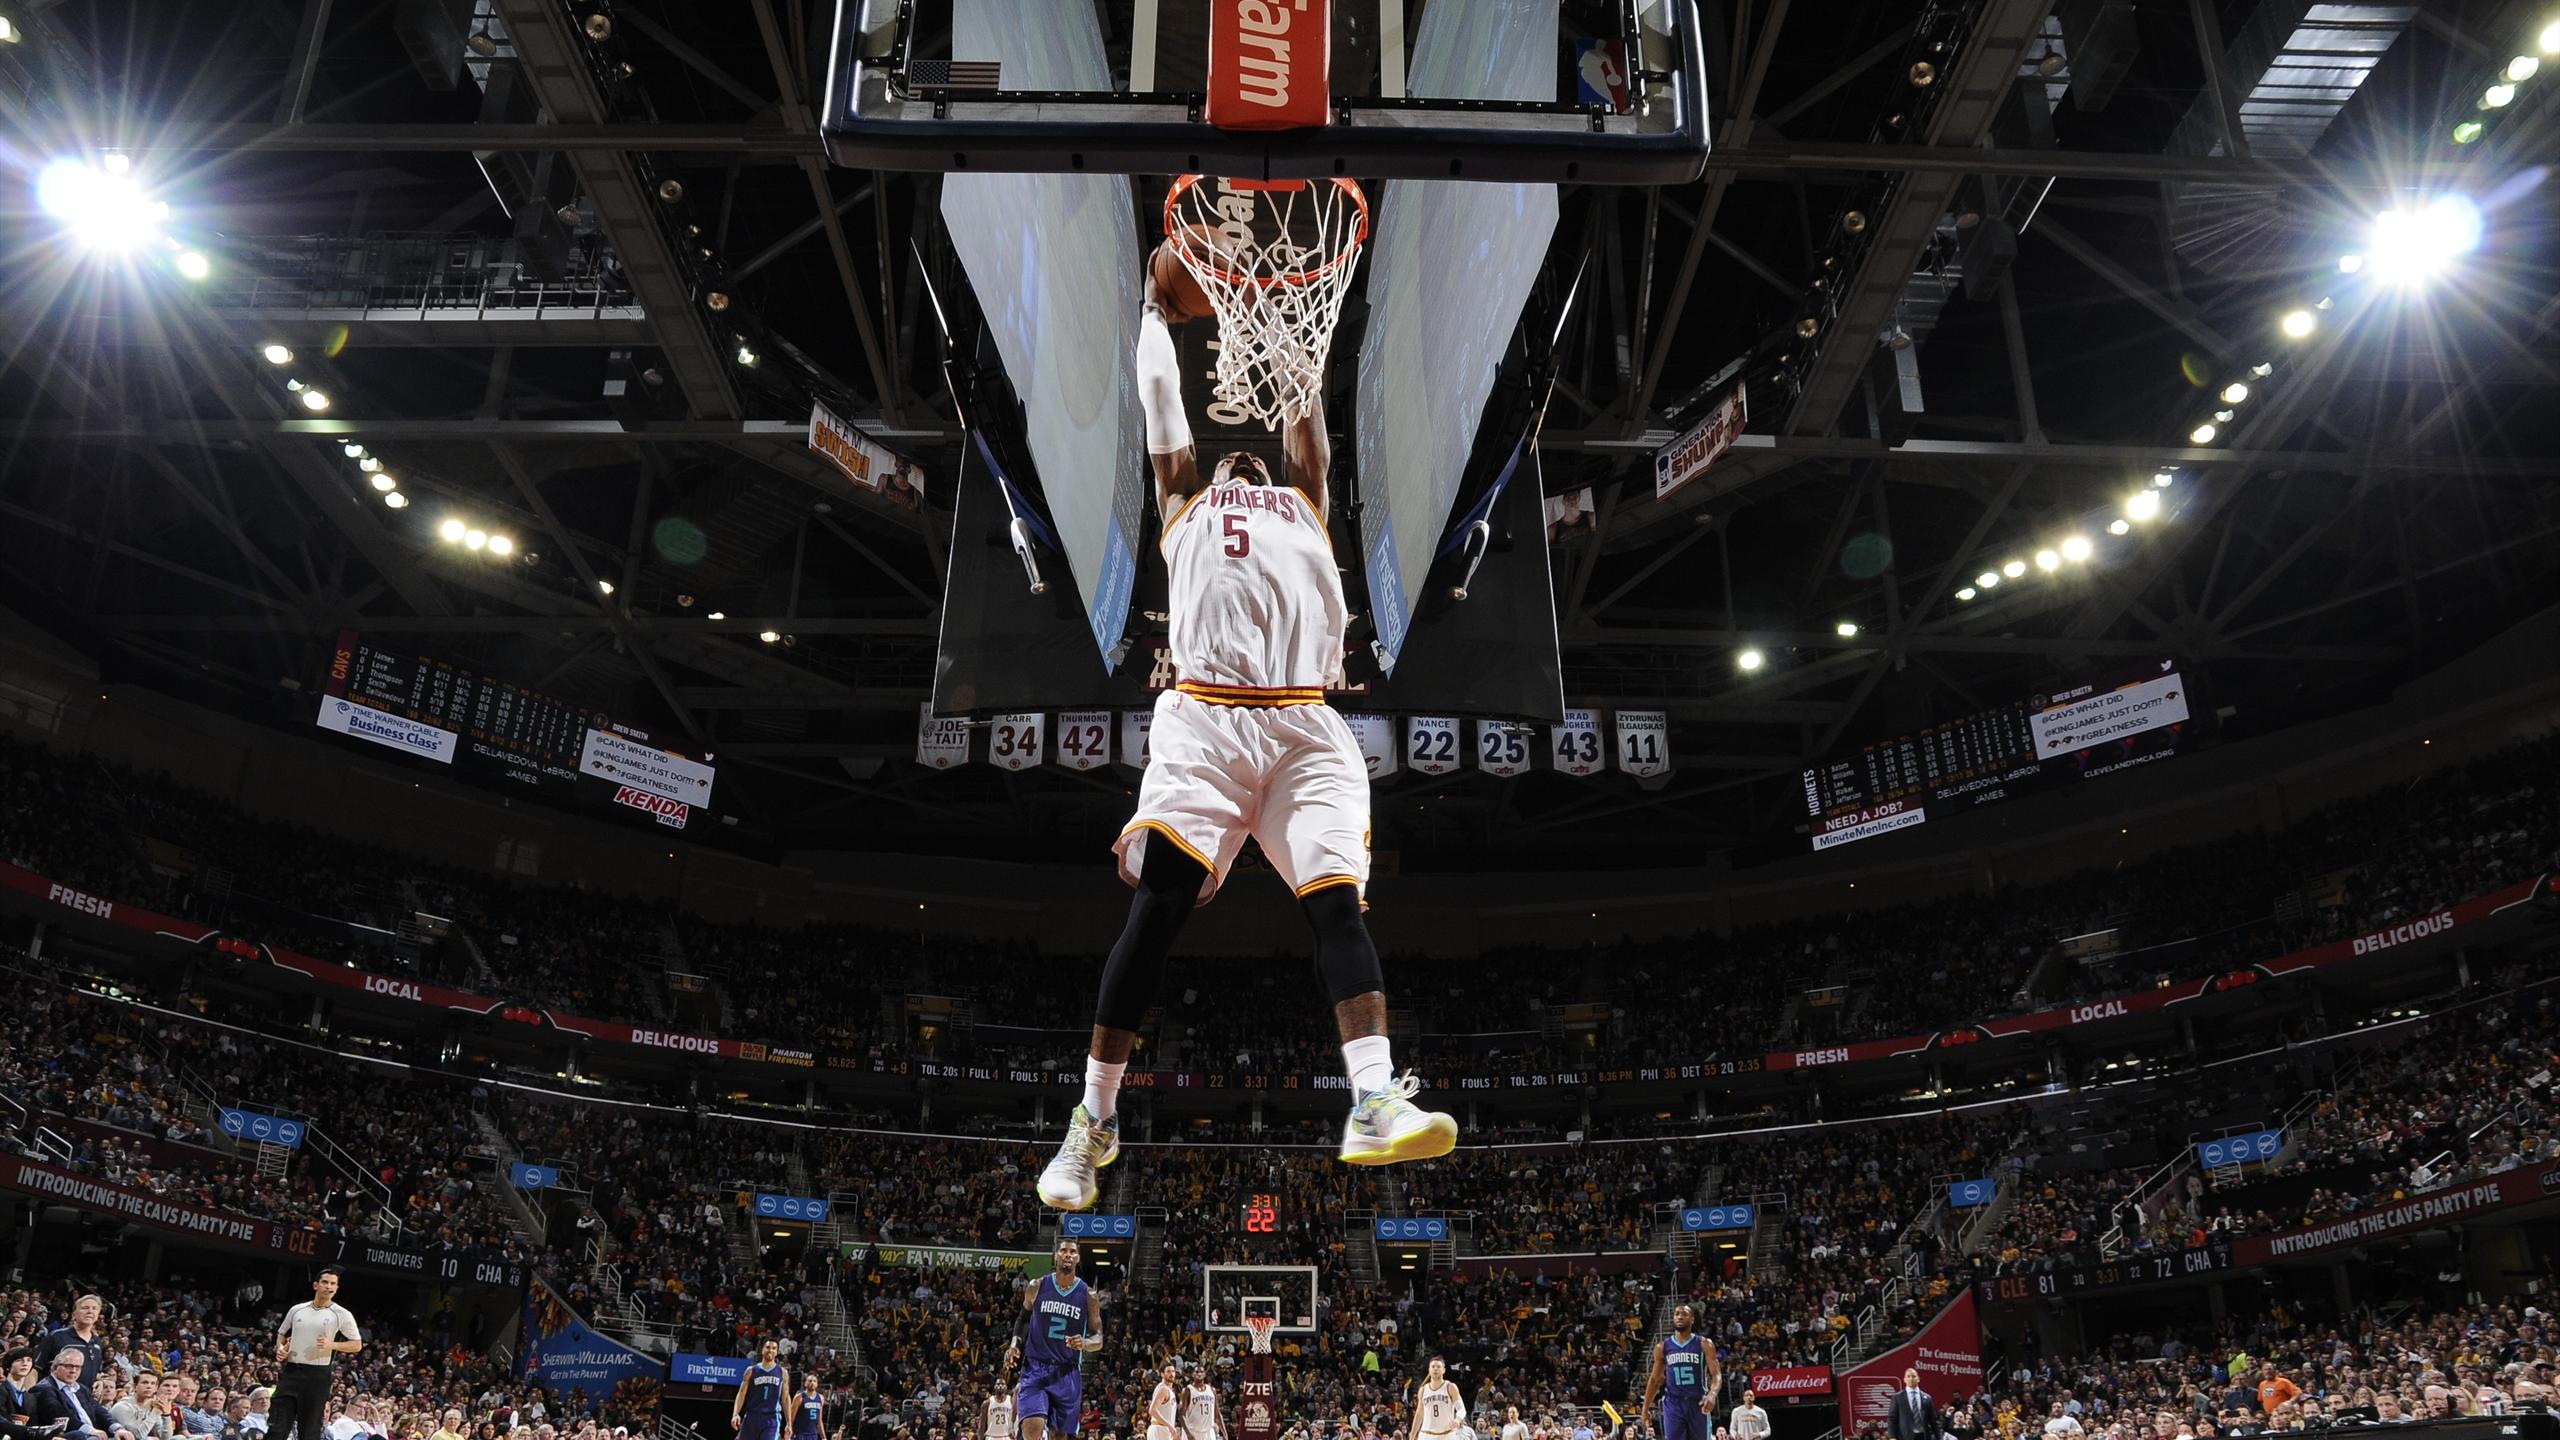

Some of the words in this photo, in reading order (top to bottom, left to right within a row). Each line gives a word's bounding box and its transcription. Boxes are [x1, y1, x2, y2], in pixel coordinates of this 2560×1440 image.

[1238, 0, 1307, 107] arm
[827, 411, 862, 450] TEAM
[1670, 411, 1722, 460] GENERATION
[814, 421, 870, 480] SWISH
[1223, 514, 1250, 558] 5
[1378, 534, 1403, 648] FirstEnergy
[331, 649, 351, 680] CAVS
[1005, 714, 1032, 723] CARR
[1061, 714, 1109, 723] THURMOND
[1618, 714, 1664, 722] ZYDRUNAS
[2042, 709, 2075, 724] @CAVS
[2076, 699, 2104, 714] WHAT
[2106, 694, 2124, 706] DID
[350, 715, 404, 740] Business
[353, 707, 372, 719] TIME
[374, 713, 411, 730] WARNER
[412, 724, 440, 739] CABLE
[938, 721, 964, 731] JOE
[1417, 720, 1451, 728] NANCE
[1619, 722, 1665, 730] ILGAUSKAS
[2045, 715, 2105, 737] @KINGJAMES
[2107, 707, 2130, 720] JUST
[934, 733, 966, 744] TAIT
[996, 725, 1037, 757] 34
[1063, 725, 1104, 757] 42
[1413, 730, 1454, 761] 22
[1483, 732, 1525, 763] 25
[1558, 731, 1599, 763] 43
[1627, 734, 1660, 763] 11
[596, 736, 625, 751] @CAVS
[628, 745, 653, 759] WHAT
[653, 753, 668, 764] DID
[593, 749, 647, 771] @KINGJAMES
[649, 766, 668, 778] JUST
[2084, 748, 2175, 779] CLEVELANDYMCA.ORG
[614, 786, 689, 820] KENDA
[1803, 769, 1821, 817] HORNETS
[657, 814, 685, 828] TIRES
[1825, 814, 1858, 831] NEED
[1861, 811, 1871, 822] A
[1873, 801, 1903, 818] JOB?
[1819, 814, 1919, 847] MinuteMenInc.com
[49, 883, 113, 919] FRESH
[2352, 911, 2455, 956] DELICIOUS
[364, 975, 422, 1001] LOCAL
[2070, 1000, 2128, 1024] LOCAL
[631, 1029, 719, 1054] DELICIOUS
[767, 1055, 816, 1068] FIREWORKS
[772, 1048, 813, 1060] PHANTOM
[1795, 1047, 1849, 1068] FRESH
[961, 1066, 966, 1079] 1
[969, 1067, 990, 1080] FULL
[1010, 1070, 1038, 1083] FOULS
[1041, 1072, 1048, 1084] 3
[1058, 1073, 1080, 1084] FG%
[1558, 1073, 1579, 1084] FULL
[1582, 1072, 1589, 1083] 3
[1619, 1070, 1633, 1081] PM
[1640, 1068, 1658, 1080] PHI
[1664, 1067, 1676, 1080] 36
[1682, 1065, 1701, 1078] DET
[1704, 1063, 1717, 1076] 55
[1737, 1059, 1760, 1073] 2:35
[1124, 1073, 1154, 1087] CAVS
[1176, 1074, 1190, 1087] 81
[1209, 1074, 1224, 1088] 22
[1243, 1075, 1269, 1088] 3:31
[1313, 1076, 1352, 1090] HORNE
[1436, 1078, 1450, 1089] 48
[1462, 1077, 1490, 1088] FOULS
[1492, 1077, 1500, 1088] 2
[17, 1165, 116, 1209] INTRODUCING
[116, 1193, 143, 1216] THE
[144, 1200, 179, 1224] CAVS
[181, 1209, 227, 1235] PARTY
[229, 1220, 254, 1241] PIE
[1252, 1194, 1280, 1208] 3:31
[1247, 1208, 1275, 1232] 22
[2270, 1220, 2360, 1256] INTRODUCING
[2360, 1214, 2387, 1237] THE
[2387, 1204, 2423, 1230] CAVS
[2424, 1191, 2473, 1221] PARTY
[2473, 1183, 2501, 1207] PIE
[271, 1234, 283, 1249] 53
[288, 1229, 318, 1255] CLE
[336, 1240, 345, 1260] 7
[366, 1248, 424, 1270] TURNOVERS
[440, 1257, 458, 1279] 10
[906, 1250, 933, 1266] FAN
[936, 1251, 973, 1267] ZONE
[975, 1255, 1030, 1270] SUBWAY
[2154, 1257, 2173, 1279] 72
[2184, 1250, 2212, 1273] CHA
[2220, 1252, 2227, 1268] 2
[475, 1262, 503, 1285] CHA
[509, 1273, 521, 1287] 48
[2130, 1265, 2141, 1279] 22
[1986, 1287, 1993, 1302] 3
[2000, 1276, 2029, 1299] CLE
[2038, 1274, 2056, 1295] 81
[1040, 1300, 1081, 1320] HORNETS
[1048, 1317, 1068, 1340] 2
[1666, 1353, 1700, 1365] HORNETS
[1918, 1347, 1933, 1358] The
[1934, 1348, 1980, 1362] Convenience
[1673, 1366, 1695, 1386] 15
[1915, 1360, 1938, 1372] Stores
[1940, 1363, 1949, 1375] of
[754, 1375, 780, 1386] HORNETS
[1246, 1383, 1270, 1396] ZTE
[1753, 1374, 1828, 1392] Budweiser
[763, 1386, 769, 1400] 1
[810, 1409, 817, 1419] 5
[1200, 1403, 1209, 1415] 13
[1433, 1404, 1439, 1417] 8
[995, 1415, 1006, 1425] 23
